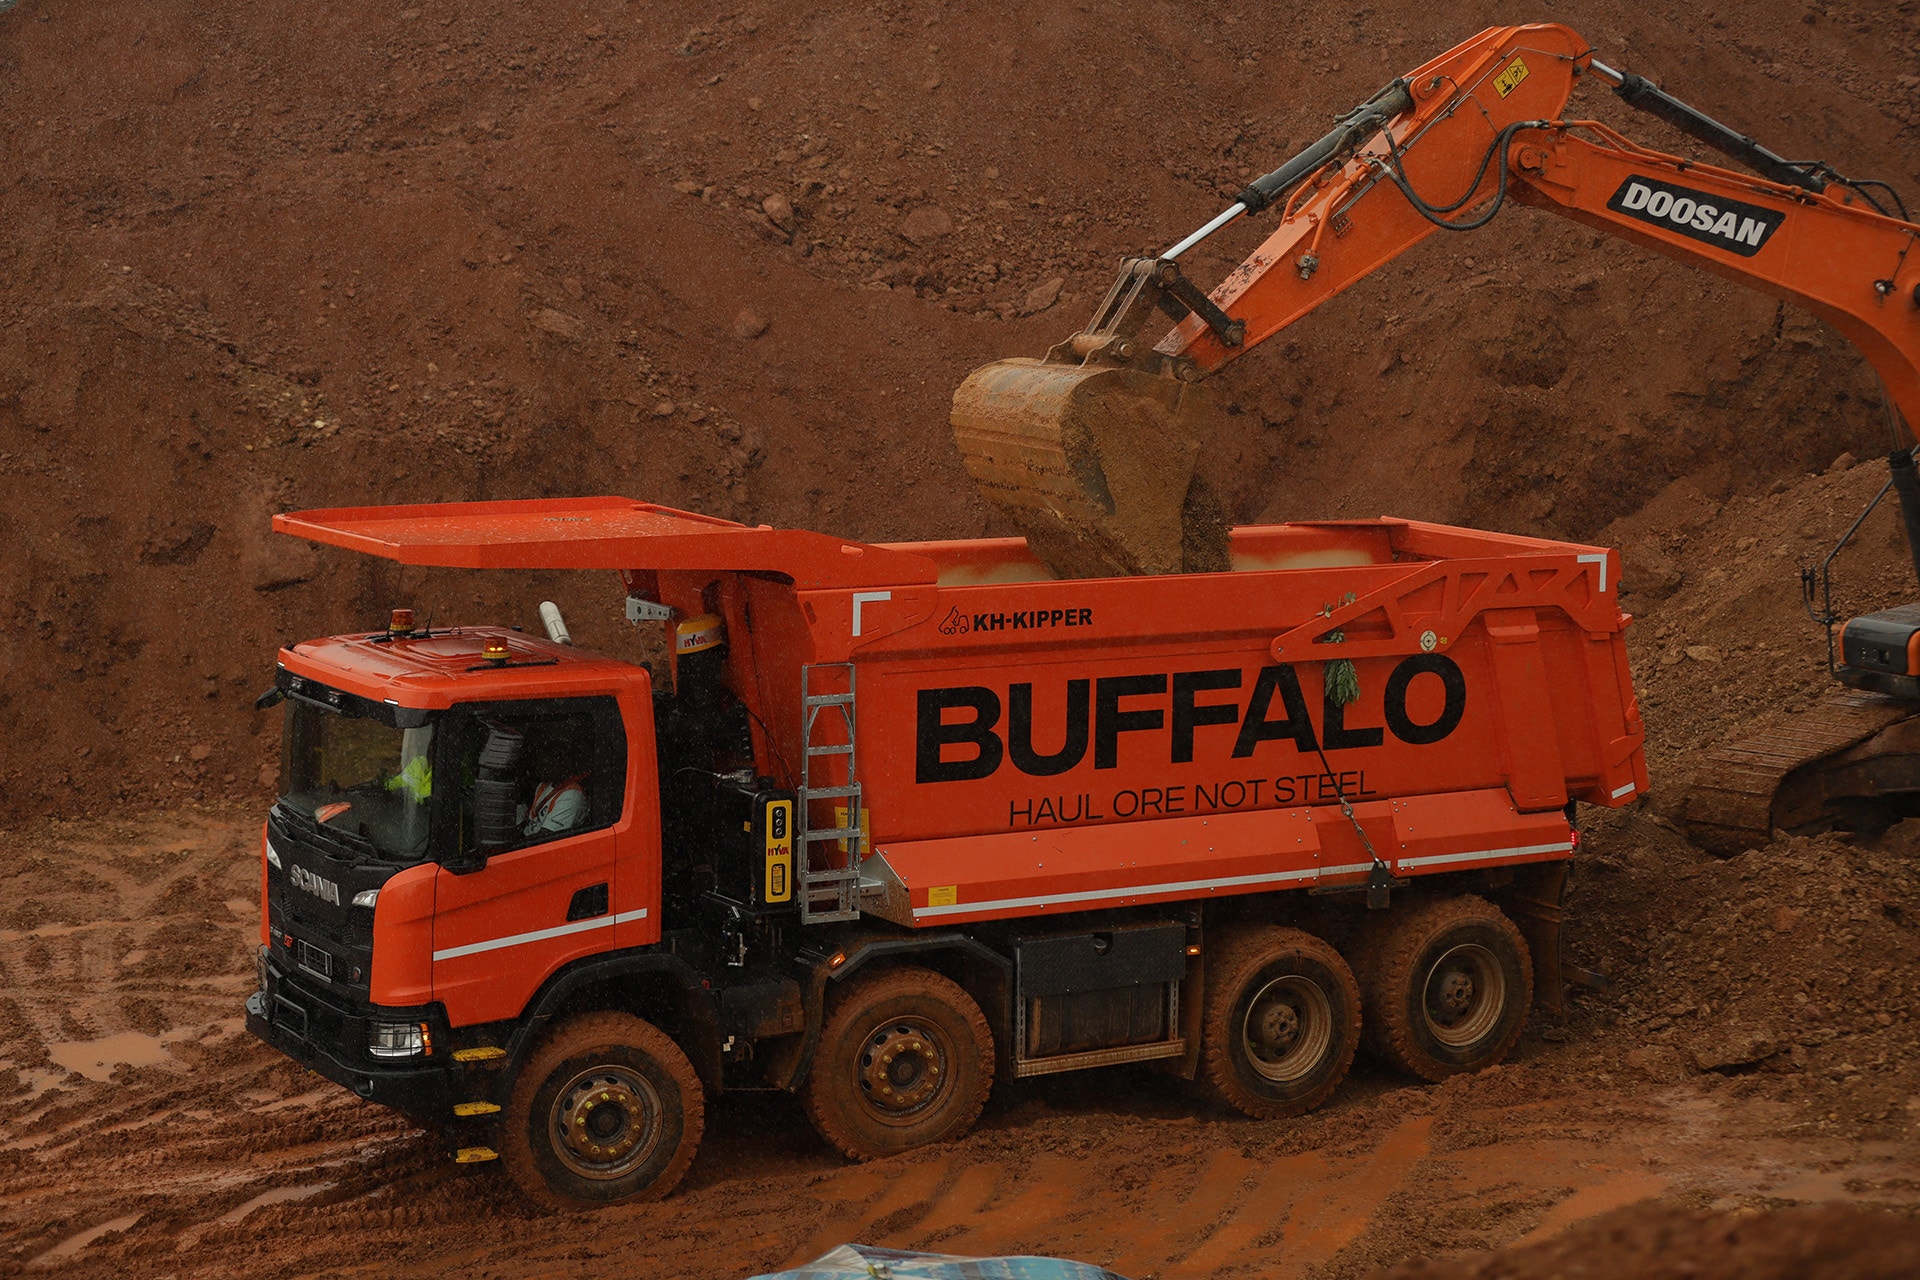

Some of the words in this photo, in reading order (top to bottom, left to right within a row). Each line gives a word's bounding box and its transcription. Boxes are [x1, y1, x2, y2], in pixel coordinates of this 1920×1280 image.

[1621, 182, 1767, 247] DOOSAN
[683, 634, 707, 648] HYVA
[973, 608, 1093, 632] KH-KIPPER
[916, 653, 1466, 784] BUFFALO
[1009, 796, 1103, 827] HAUL
[1113, 786, 1185, 815] ORE
[1195, 779, 1267, 810] NOT
[1274, 770, 1377, 803] STEEL
[768, 844, 789, 856] HYVA
[290, 864, 340, 907] SCANIA
